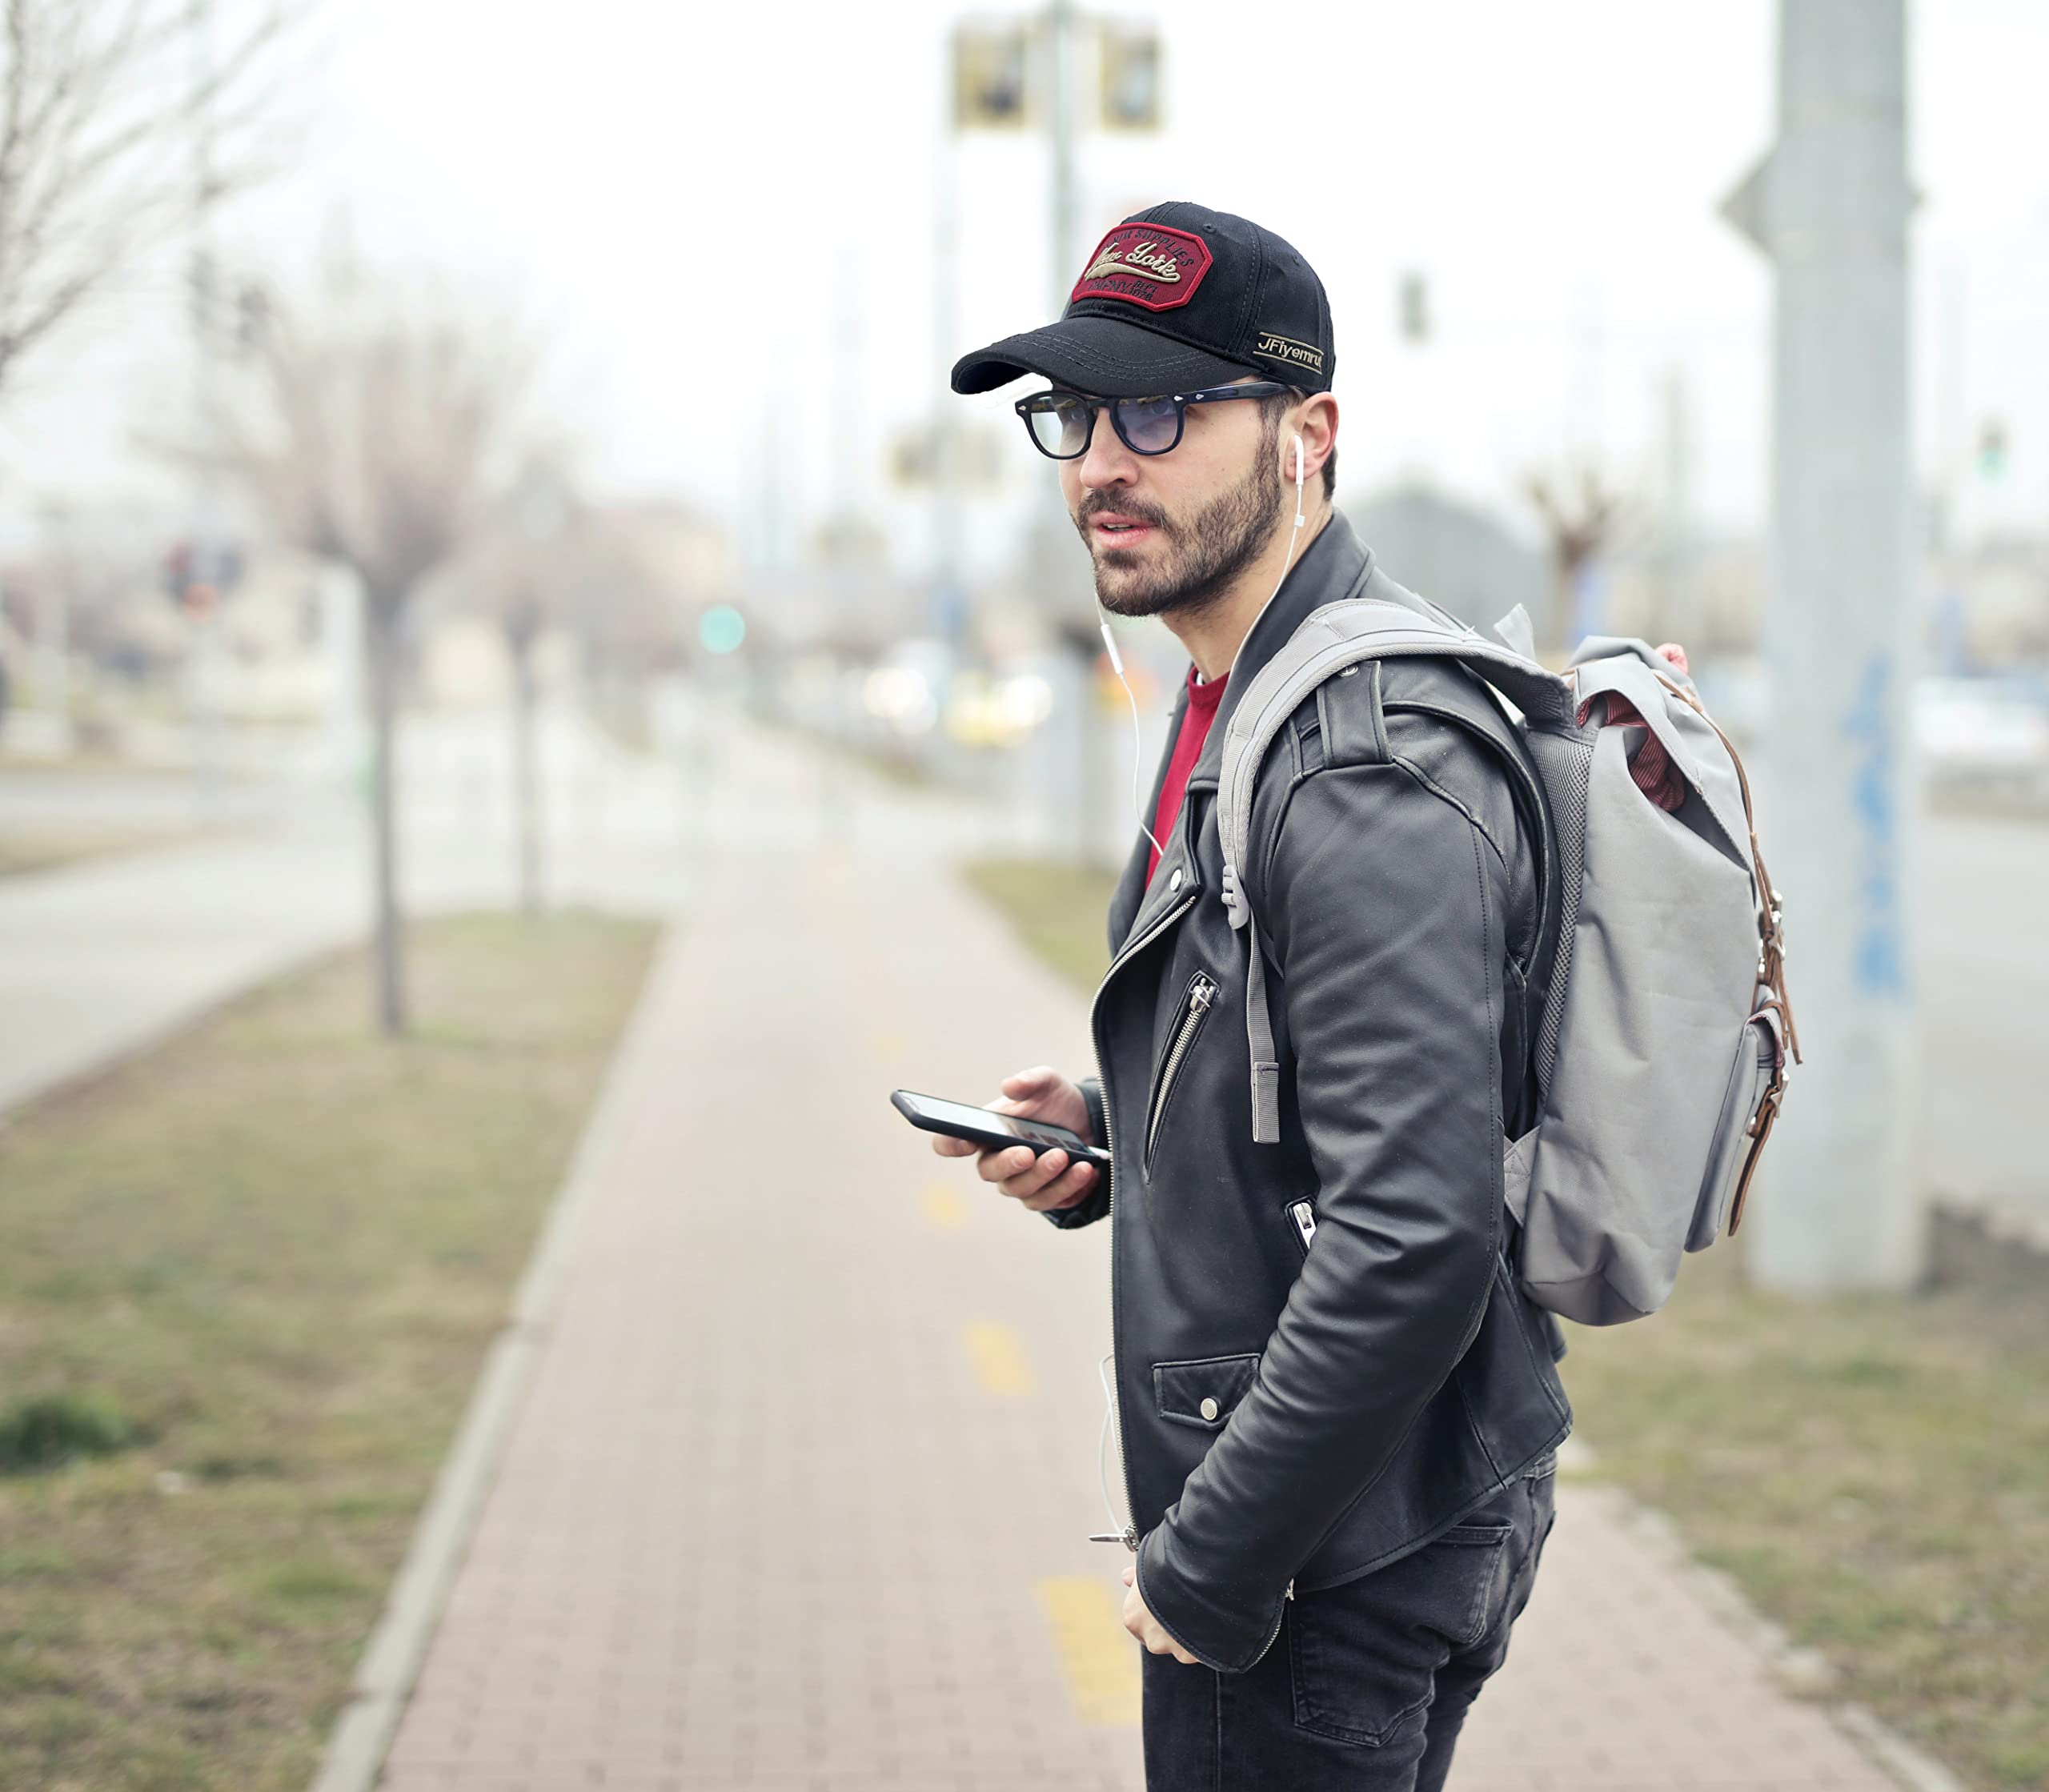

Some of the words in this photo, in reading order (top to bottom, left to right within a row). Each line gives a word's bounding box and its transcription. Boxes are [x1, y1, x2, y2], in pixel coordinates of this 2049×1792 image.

[1086, 242, 1123, 275] New
[1125, 242, 1177, 276] York
[1134, 229, 1195, 267] SUPPLIES
